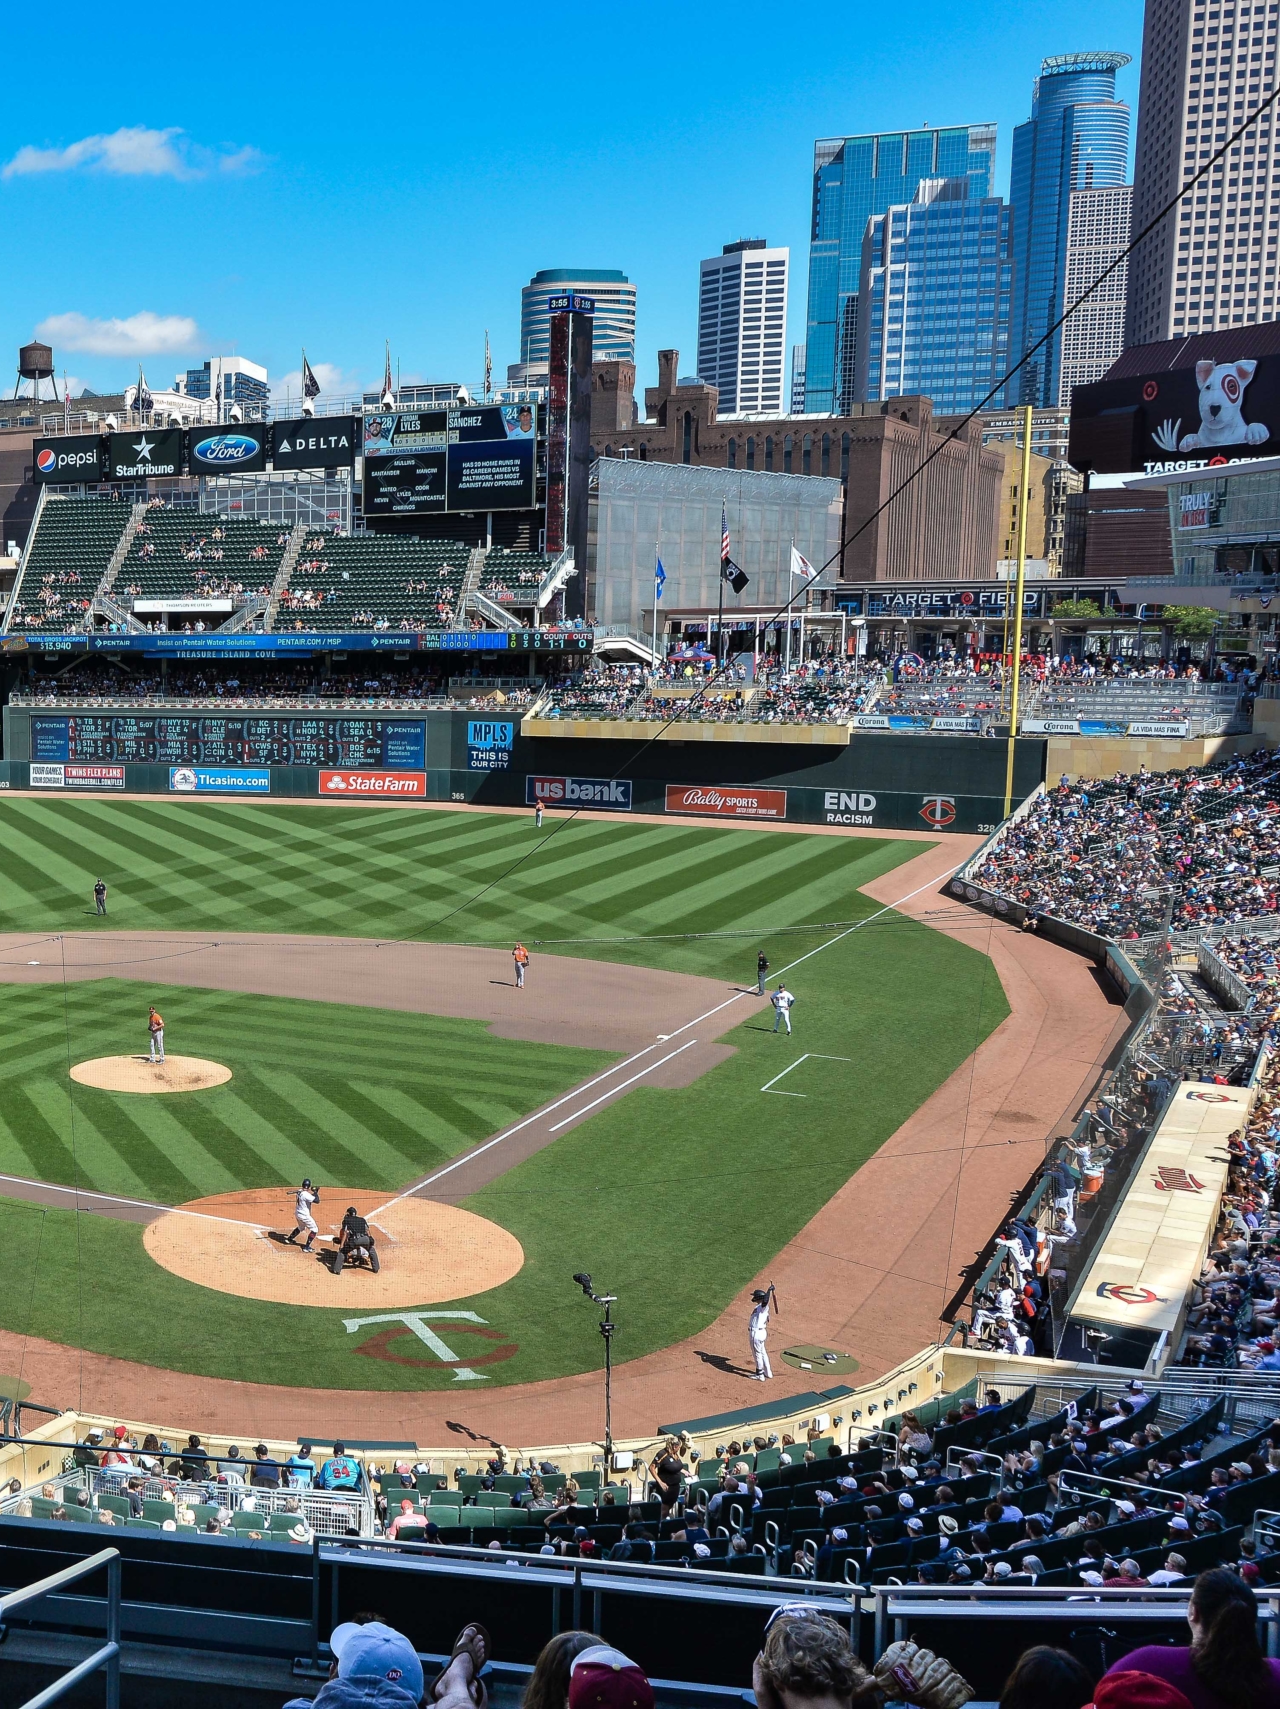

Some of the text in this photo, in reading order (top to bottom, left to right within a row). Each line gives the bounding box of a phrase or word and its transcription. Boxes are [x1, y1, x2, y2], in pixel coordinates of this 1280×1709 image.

[551, 298, 568, 307] 3:55
[506, 408, 518, 420] 24
[381, 416, 393, 428] 28
[400, 421, 420, 431] LYLES
[449, 416, 482, 428] SANCHEZ
[206, 436, 246, 460] Ford
[296, 436, 349, 451] DELTA
[58, 449, 98, 469] pepsi
[116, 463, 175, 477] StarTribune
[1143, 460, 1209, 473] TARGET
[1180, 493, 1211, 511] TRULY
[882, 593, 956, 605] TARGET
[858, 717, 885, 726] Corona
[1043, 721, 1074, 731] Corona
[473, 723, 507, 742] MPLS
[471, 751, 508, 760] THIS IS
[489, 760, 508, 768] CITY
[68, 768, 121, 777] TWINS FLEX PLANS
[199, 775, 268, 787] TIcasino.com
[451, 792, 464, 800] 365
[683, 789, 758, 810] Bally SPORTS
[825, 791, 877, 812] END
[826, 812, 873, 825] RACISM
[977, 824, 995, 832] 328
